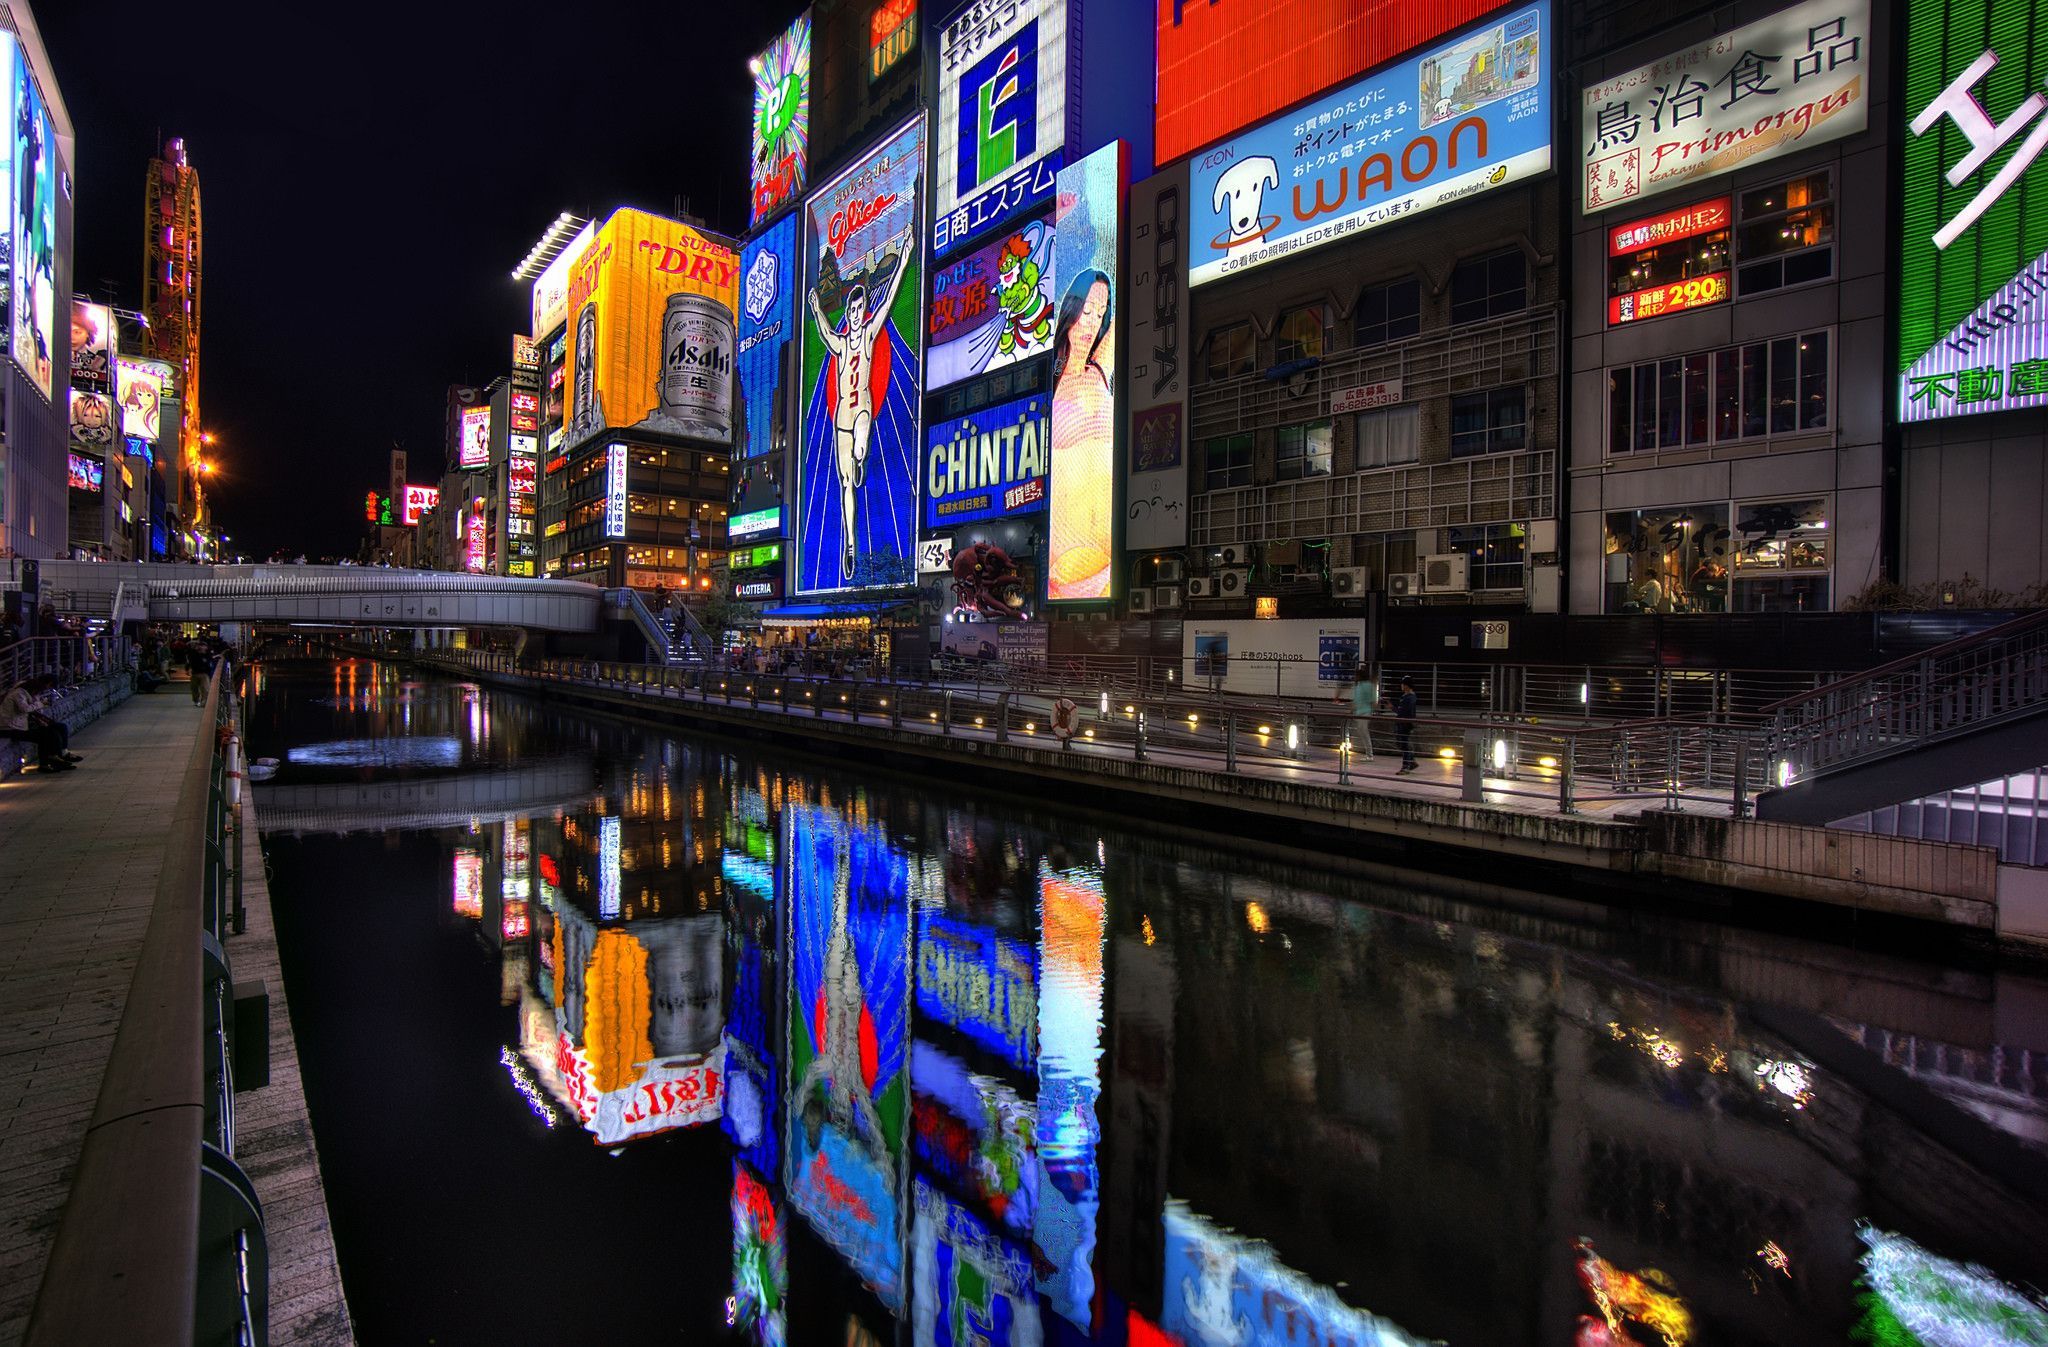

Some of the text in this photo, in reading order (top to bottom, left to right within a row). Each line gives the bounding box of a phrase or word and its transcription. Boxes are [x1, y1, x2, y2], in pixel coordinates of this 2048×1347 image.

[1293, 88, 1386, 137] お買物のたびに
[1507, 105, 1538, 123] WAON
[1292, 127, 1404, 178] おトクな電子マネー
[1648, 161, 1705, 184] izakaya
[1458, 182, 1485, 196] delight
[933, 160, 1055, 251] 日商エステム
[828, 193, 897, 259] Glico
[1634, 208, 1725, 243] 情熱ホルモン
[679, 234, 732, 260] SUPER
[1639, 289, 1665, 306] 新鮮
[1669, 277, 1716, 306] 290
[930, 275, 987, 333] 改源
[1637, 304, 1666, 317] ホルモン
[1945, 254, 2048, 355] http://
[669, 338, 730, 376] Asahi
[690, 376, 708, 389] 生
[1345, 384, 1386, 400] 広告募集
[1332, 393, 1399, 412] 06-6262-1313
[742, 583, 772, 595] LOTTERIA
[1256, 598, 1277, 609] BAR
